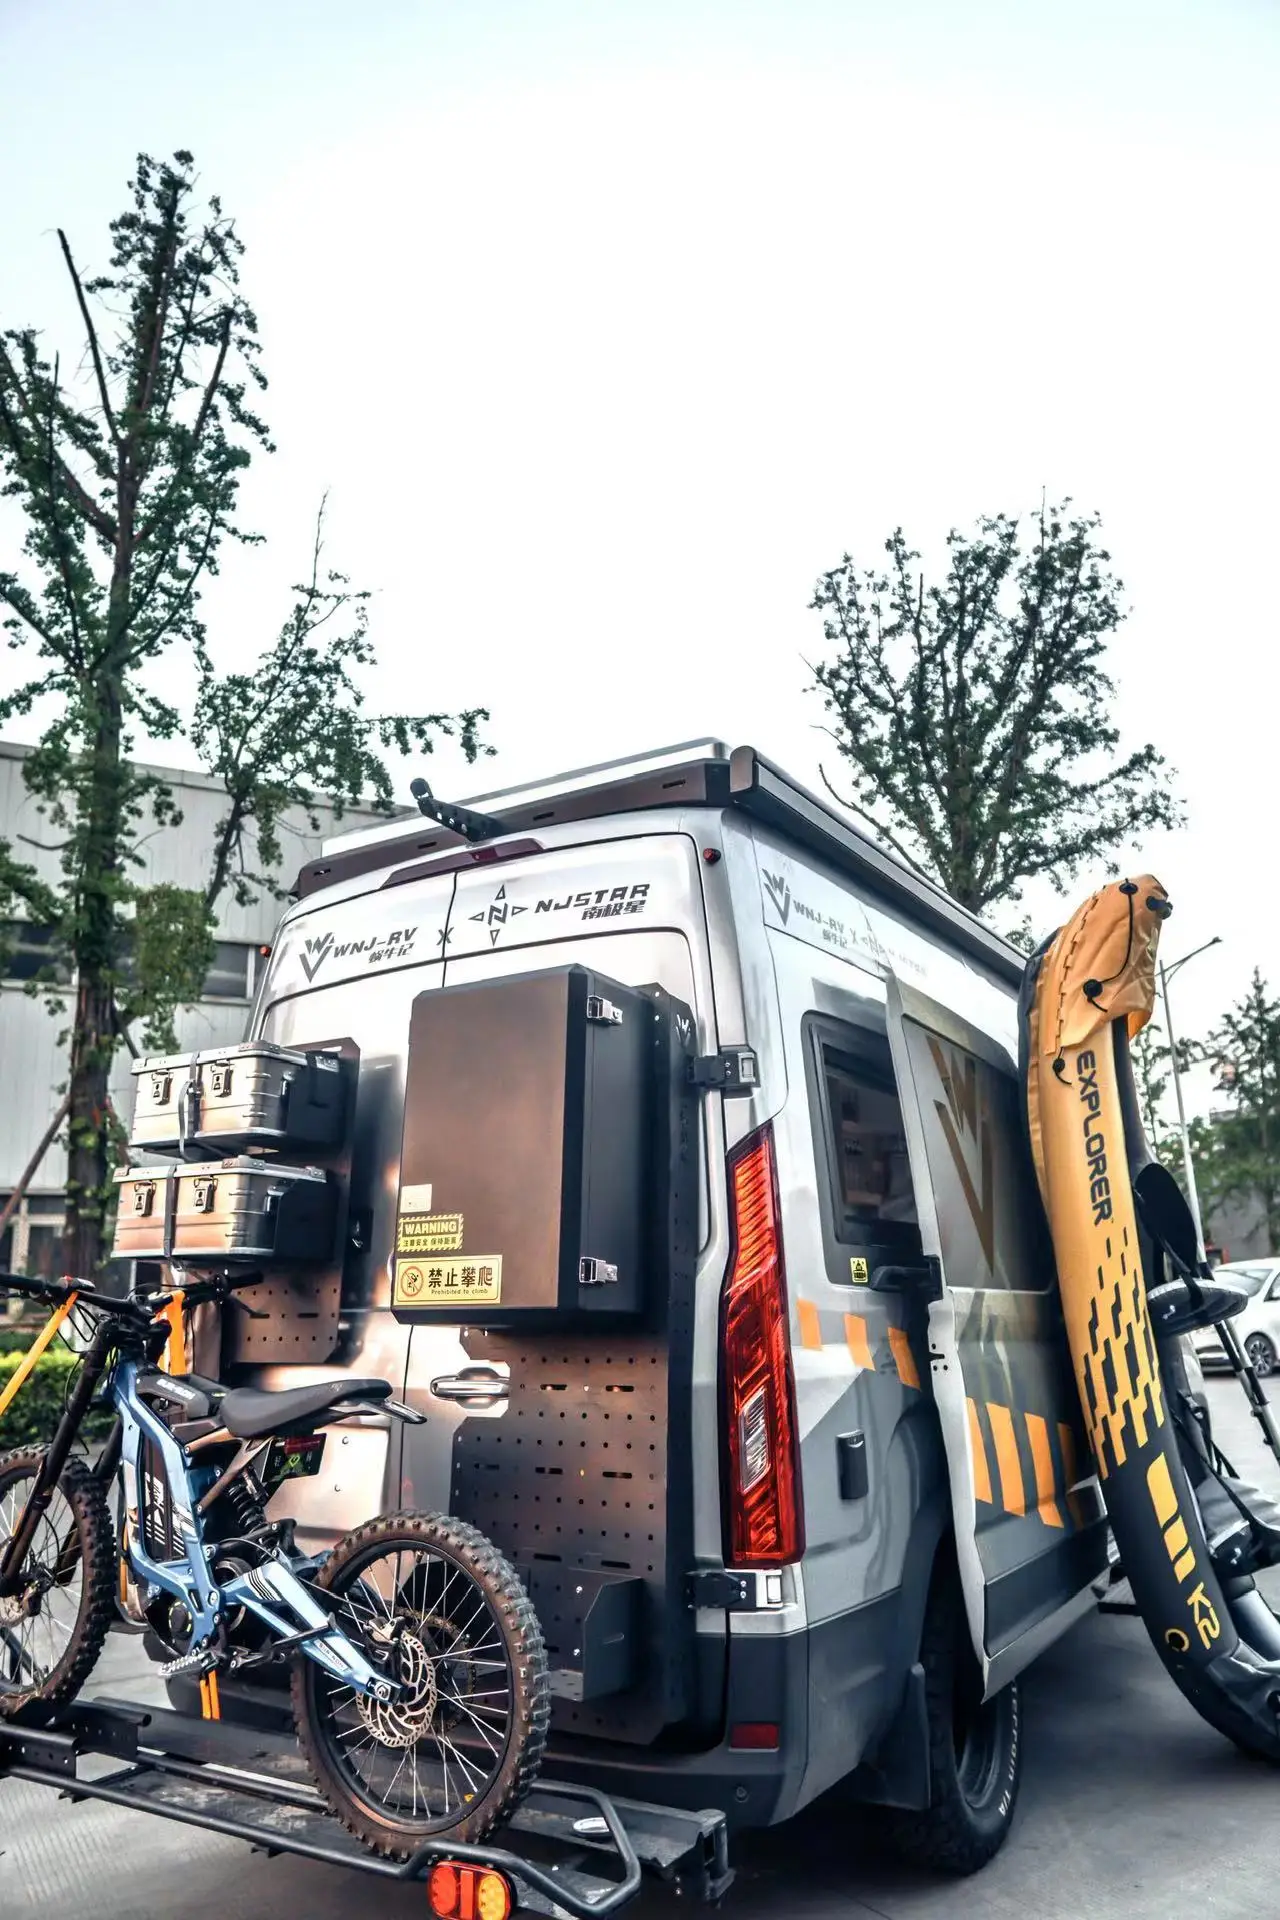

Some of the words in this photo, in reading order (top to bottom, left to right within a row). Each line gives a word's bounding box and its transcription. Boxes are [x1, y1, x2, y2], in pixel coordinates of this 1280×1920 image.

[534, 883, 650, 914] NJSTAR
[581, 899, 647, 921] 南极星
[793, 899, 845, 934] WNJ-RV
[333, 926, 419, 958] WNJ-RV
[1076, 1050, 1114, 1226] EXPLORER
[404, 1221, 457, 1235] WARNING
[428, 1266, 493, 1288] 禁止攀爬
[1187, 1581, 1220, 1650] K2
